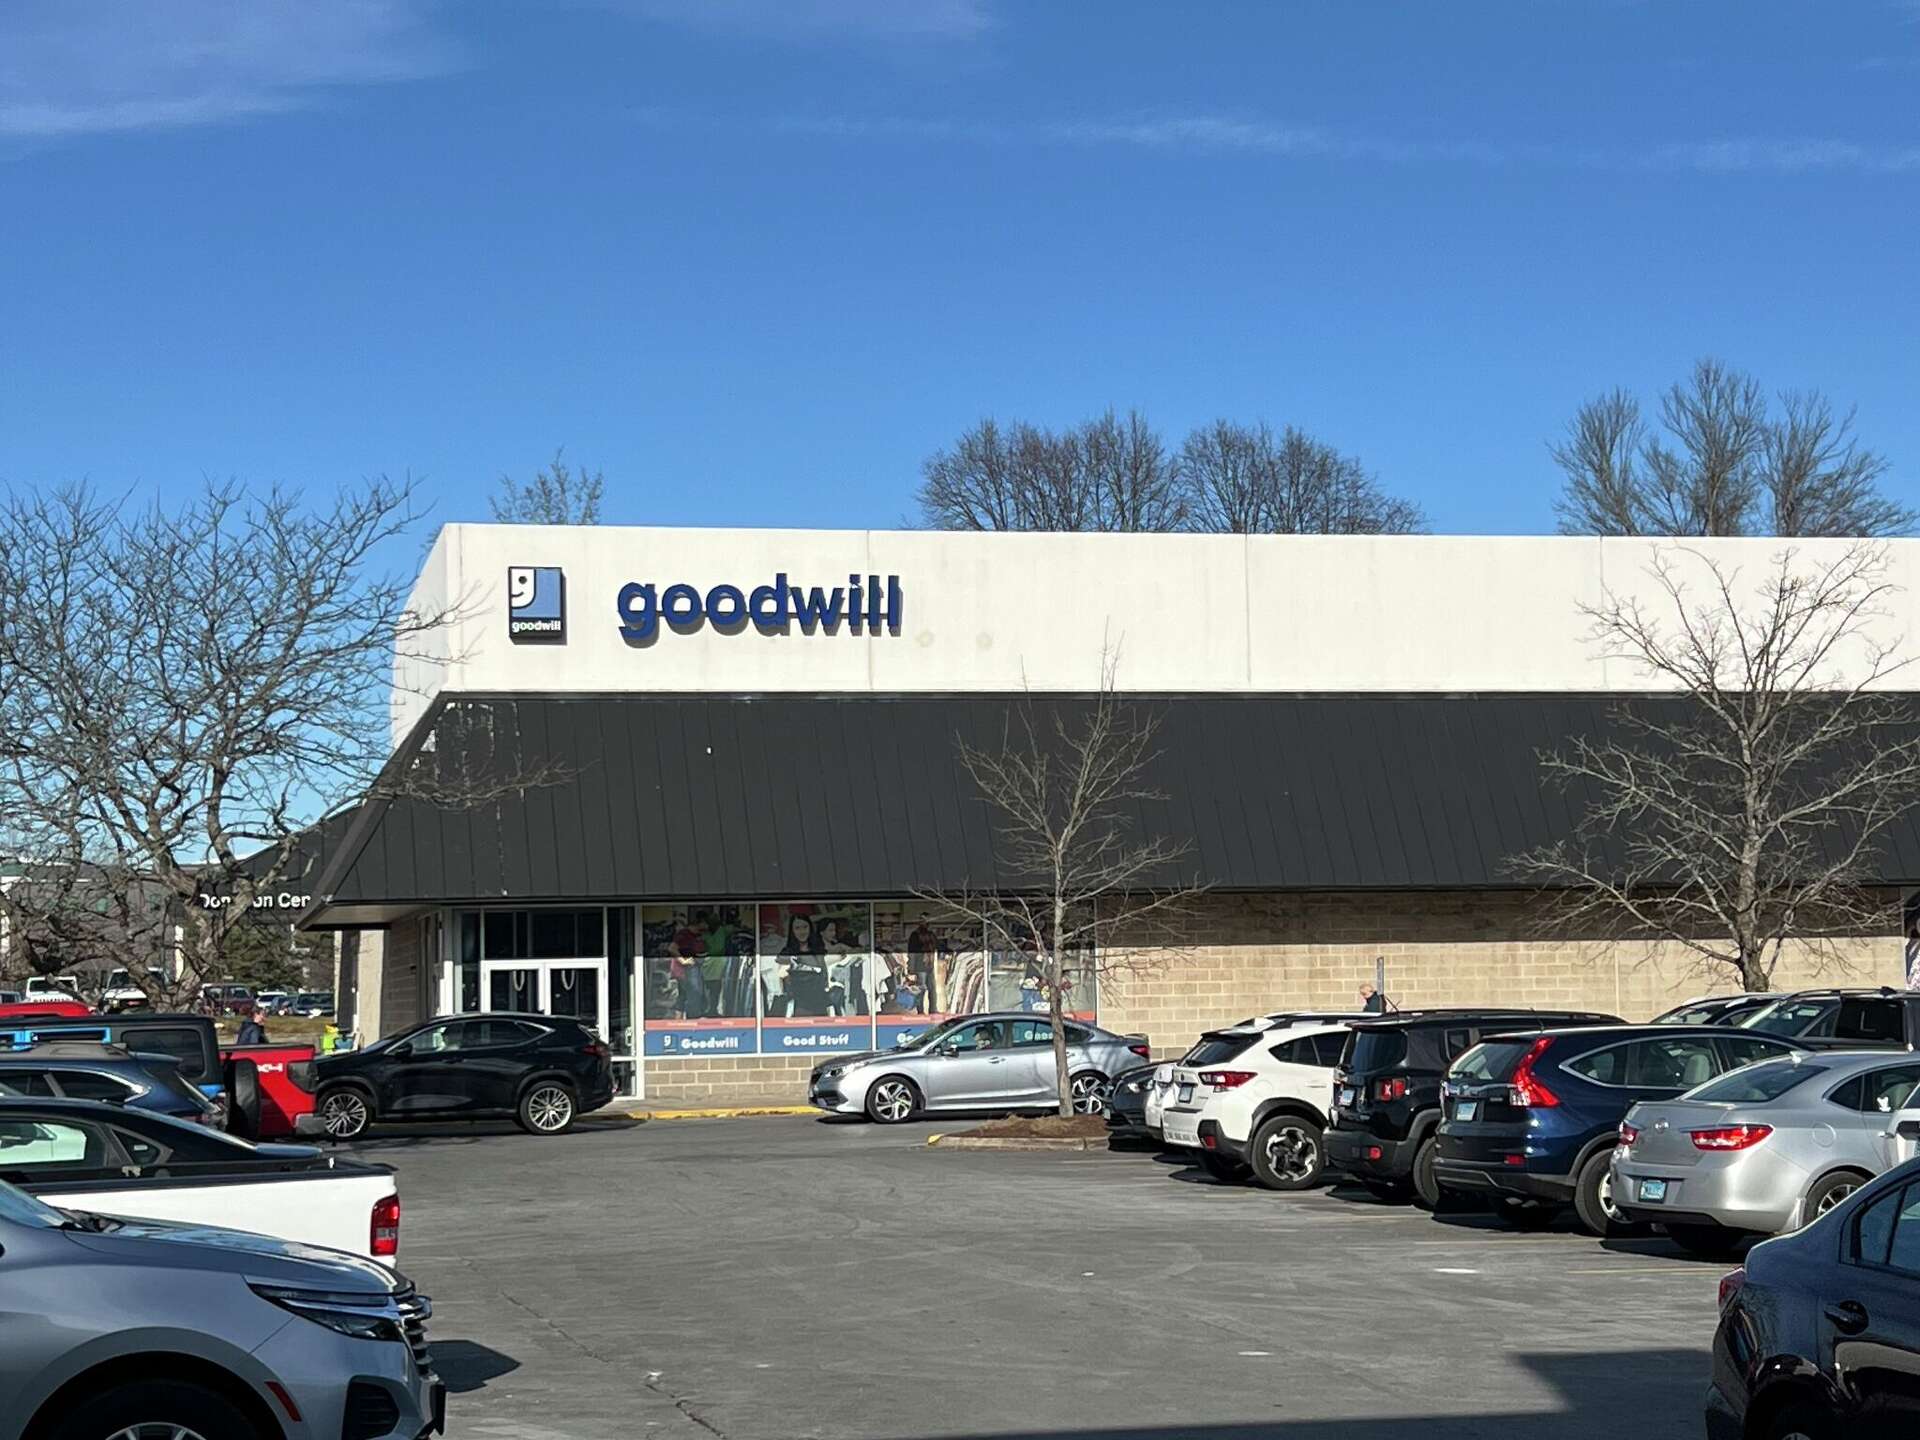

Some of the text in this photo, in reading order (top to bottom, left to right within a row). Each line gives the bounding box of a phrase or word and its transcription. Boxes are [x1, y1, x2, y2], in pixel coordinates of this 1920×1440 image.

[618, 573, 900, 638] goodwill
[511, 621, 561, 633] goodwill
[681, 1036, 739, 1049] Goodwill
[783, 1034, 849, 1046] Good Stuff
